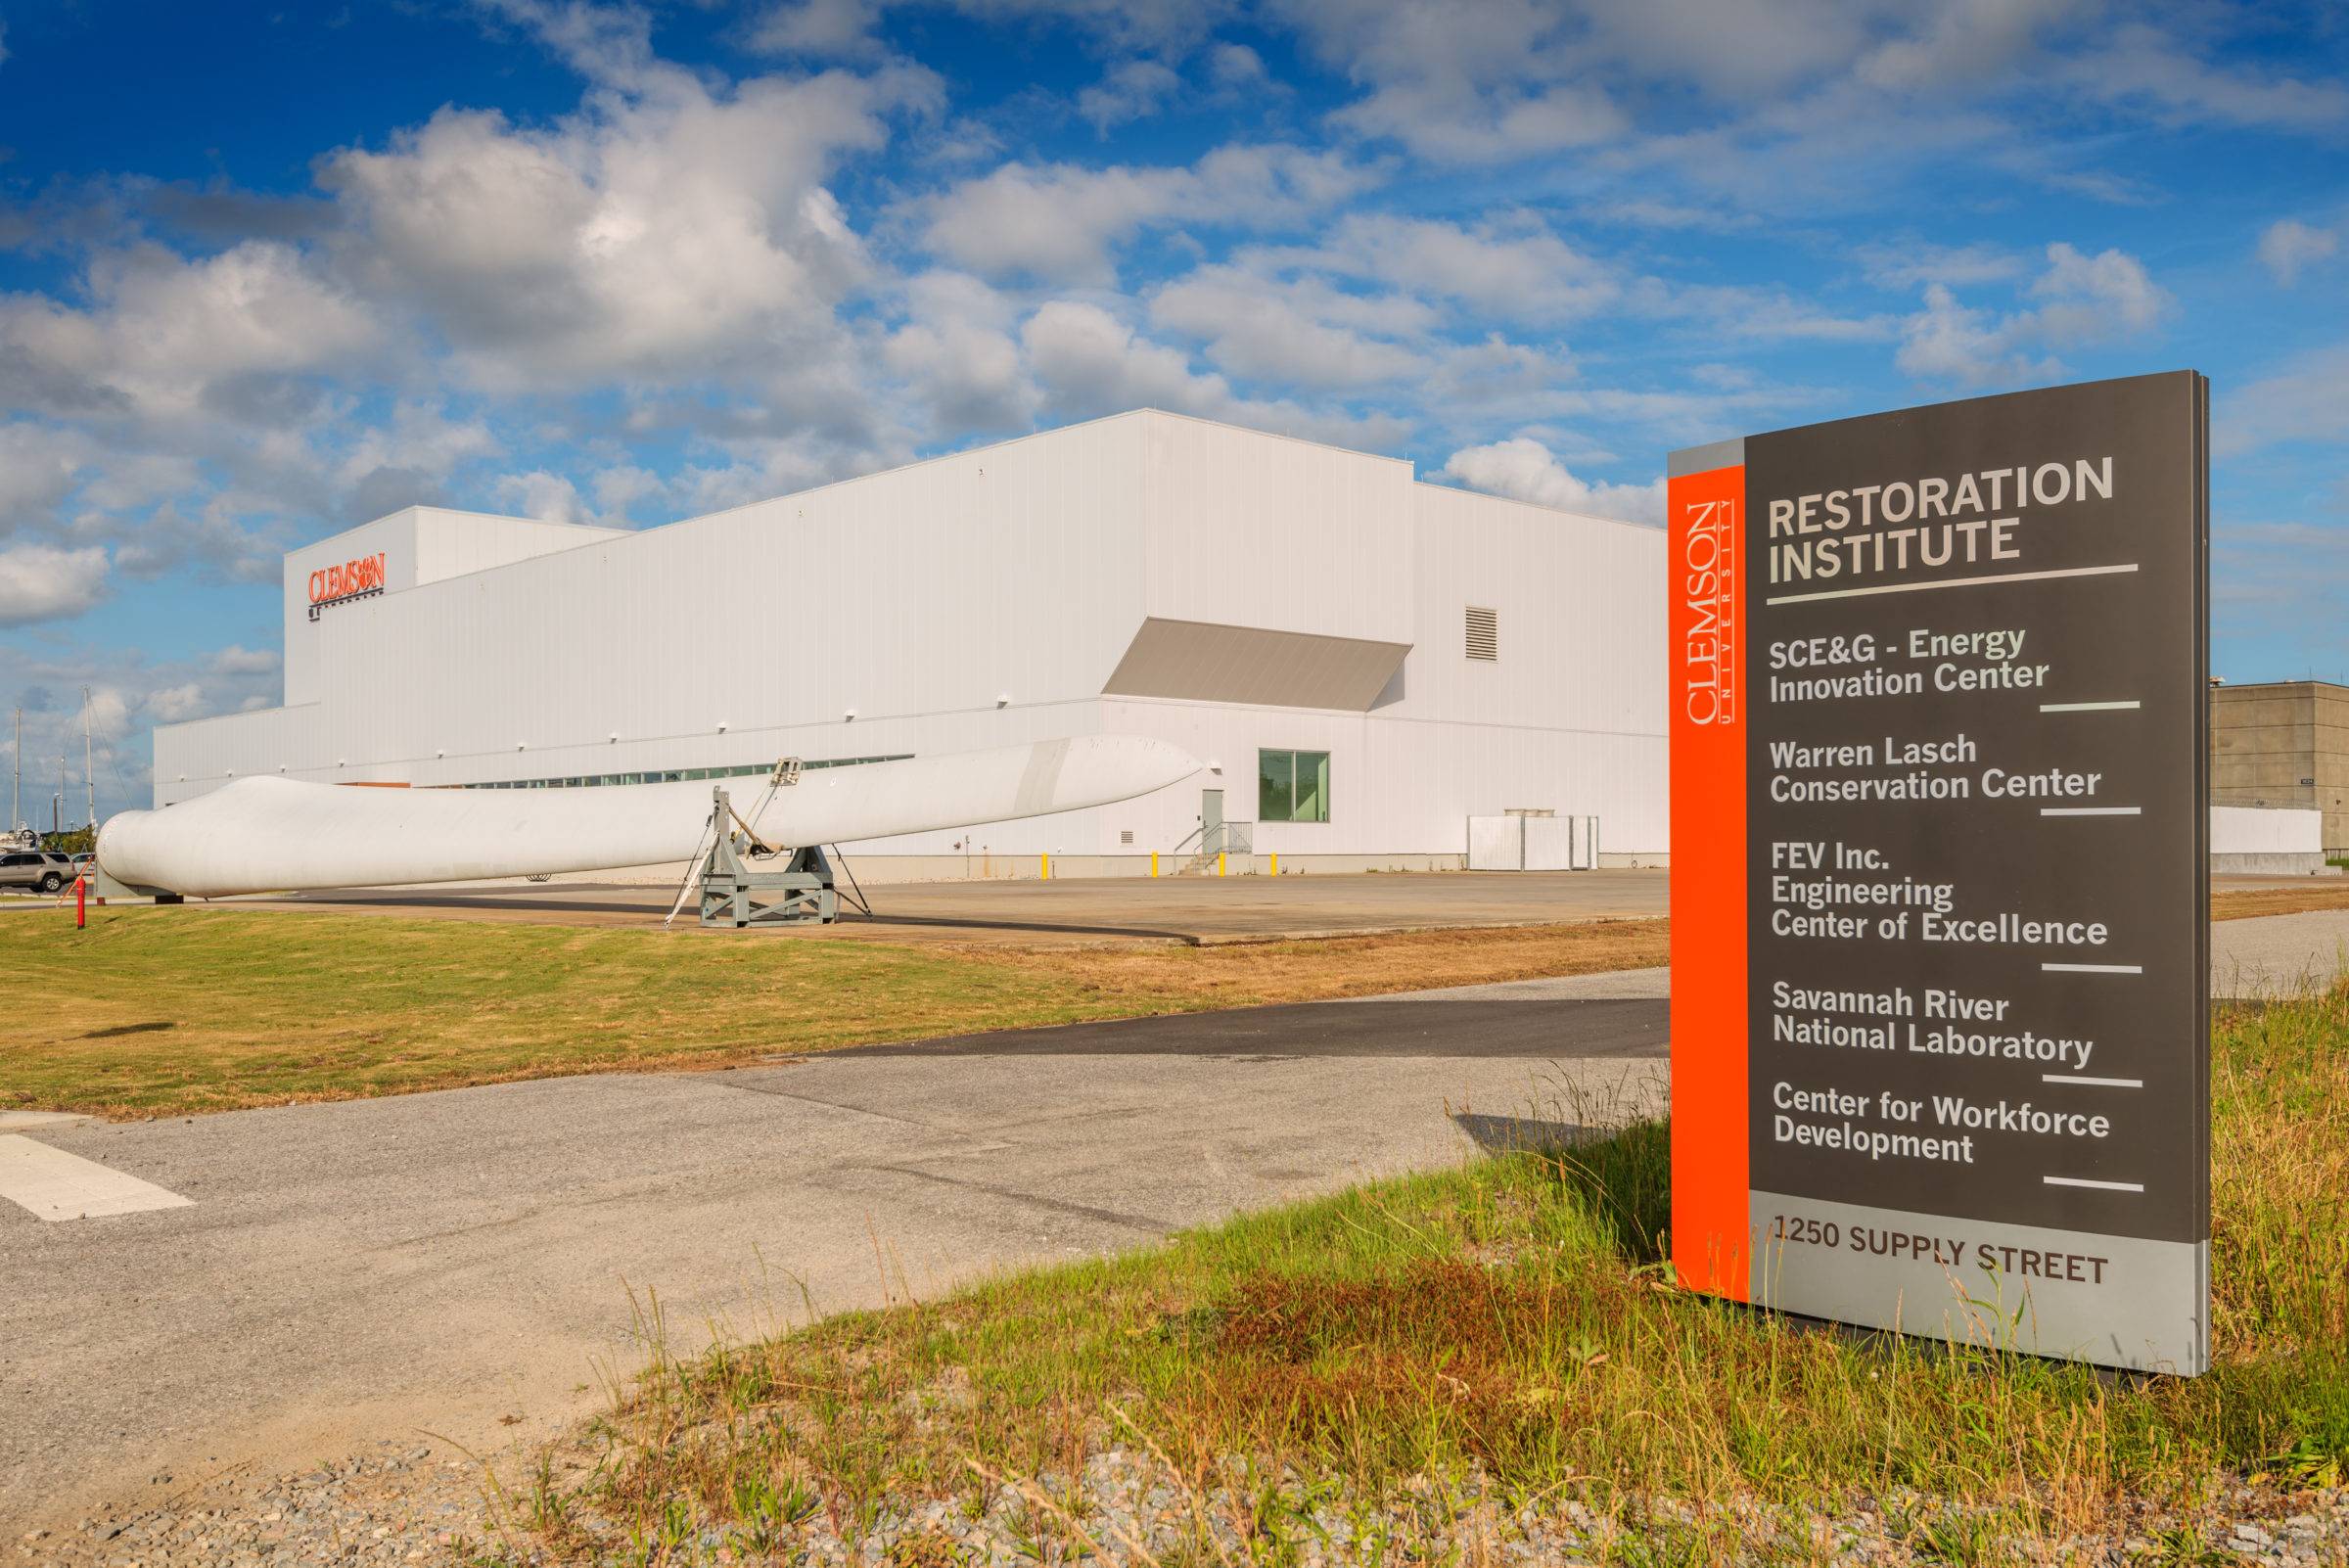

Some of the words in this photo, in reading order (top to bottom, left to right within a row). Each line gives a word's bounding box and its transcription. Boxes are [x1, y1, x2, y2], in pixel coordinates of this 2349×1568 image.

[1769, 456, 2113, 538] RESTORATION
[1770, 517, 2020, 584] INSTITUTE
[1686, 500, 1718, 725] CLEMSON
[1721, 500, 1731, 724] UNIVERSITY
[1769, 633, 1875, 669] SCE&G
[1909, 628, 2026, 663] Energy
[1771, 667, 1923, 703] Innovation
[1934, 661, 2050, 692] Center
[1769, 736, 1873, 769] Warren
[1885, 733, 1976, 765] Lasch
[1771, 767, 1968, 803] Conservation
[1981, 767, 2102, 799] Center
[1772, 842, 1825, 869] FEV
[1835, 842, 1889, 870] Inc.
[1773, 875, 1955, 913] Engineering
[1772, 908, 1868, 940] Center
[1878, 911, 1909, 940] of
[1922, 912, 2108, 945] Excellence
[1773, 981, 1912, 1017] Savannah
[1924, 989, 2009, 1022] River
[1773, 1014, 1895, 1050] National
[1909, 1023, 2094, 1070] Laboratory
[1773, 1082, 1870, 1118] Center
[1878, 1090, 1923, 1123] for
[1931, 1095, 2110, 1138] Workforce
[1774, 1114, 1974, 1164] Development
[1774, 1215, 1840, 1248] 1250
[1849, 1226, 1966, 1266] SUPPLY
[1977, 1243, 2109, 1285] STREET
